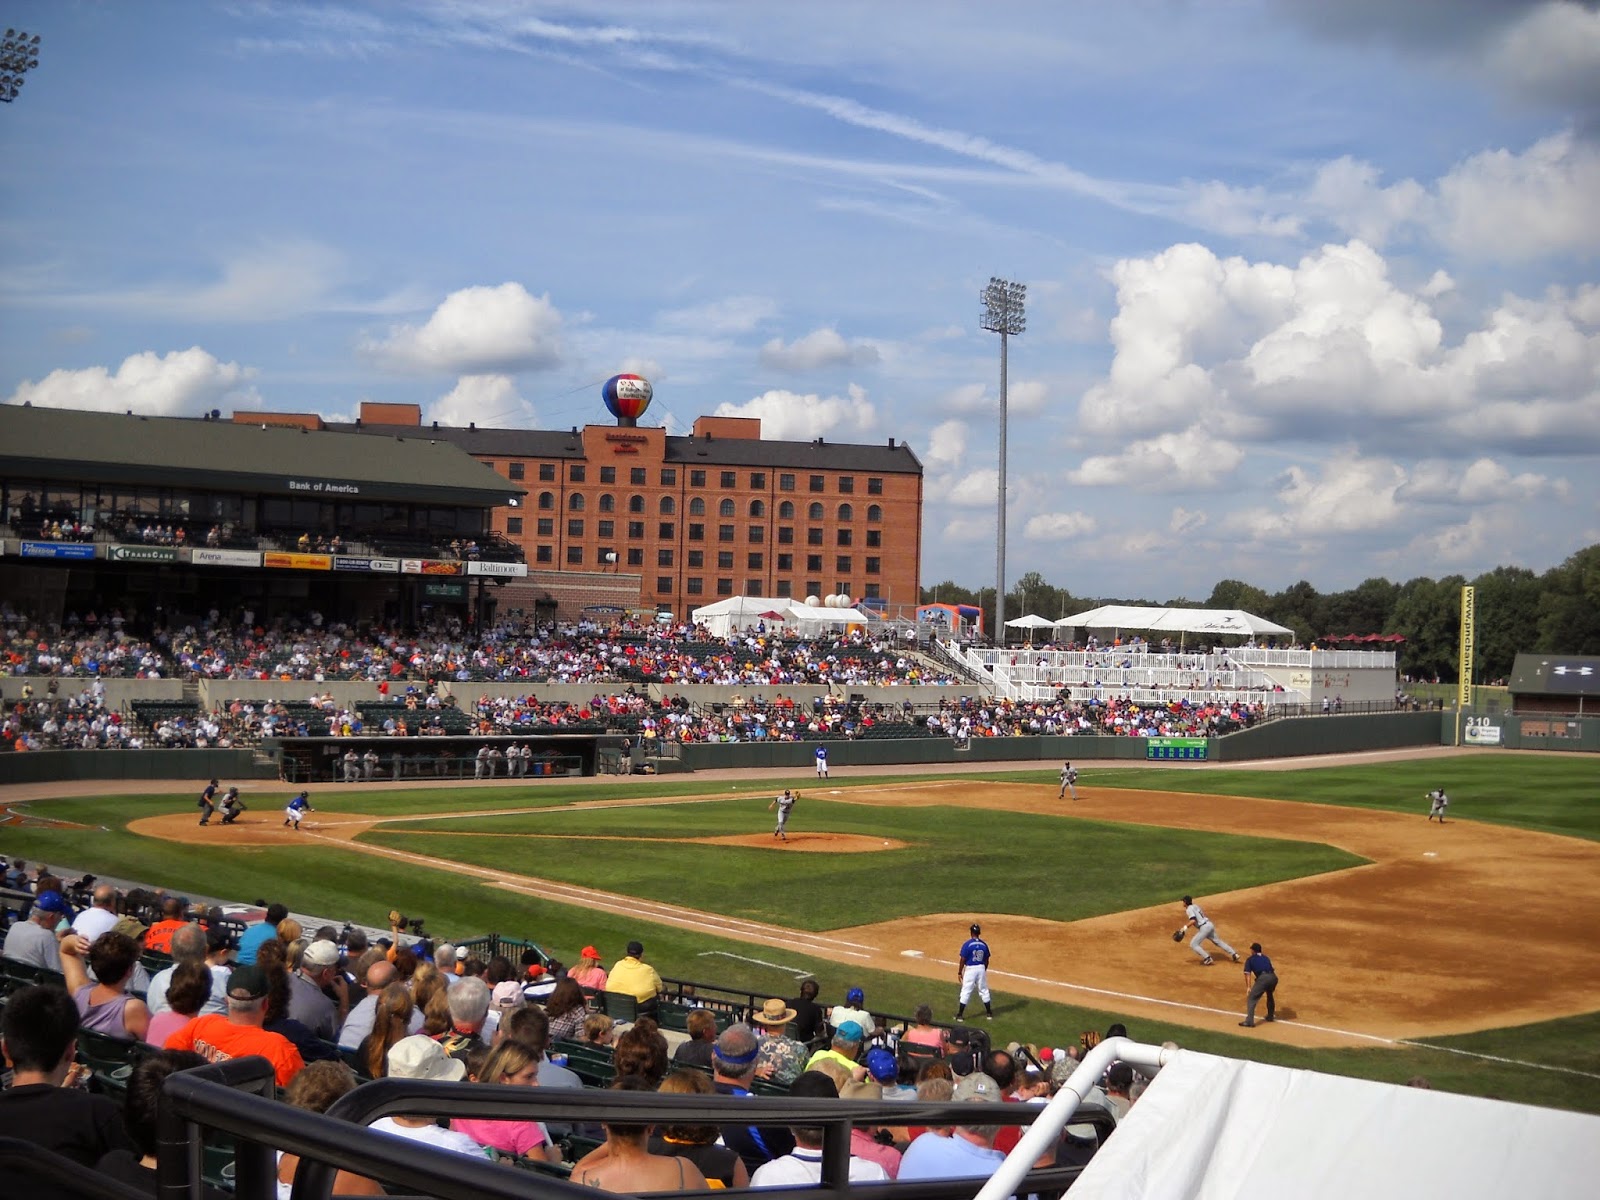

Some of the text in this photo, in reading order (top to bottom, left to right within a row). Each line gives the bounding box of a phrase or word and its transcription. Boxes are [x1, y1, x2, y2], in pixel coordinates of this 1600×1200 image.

[289, 481, 359, 493] Bank of America
[200, 552, 221, 561] Arena
[480, 562, 518, 574] Baltimore
[1463, 588, 1473, 704] www.pncbank.com
[1467, 716, 1490, 727] 310
